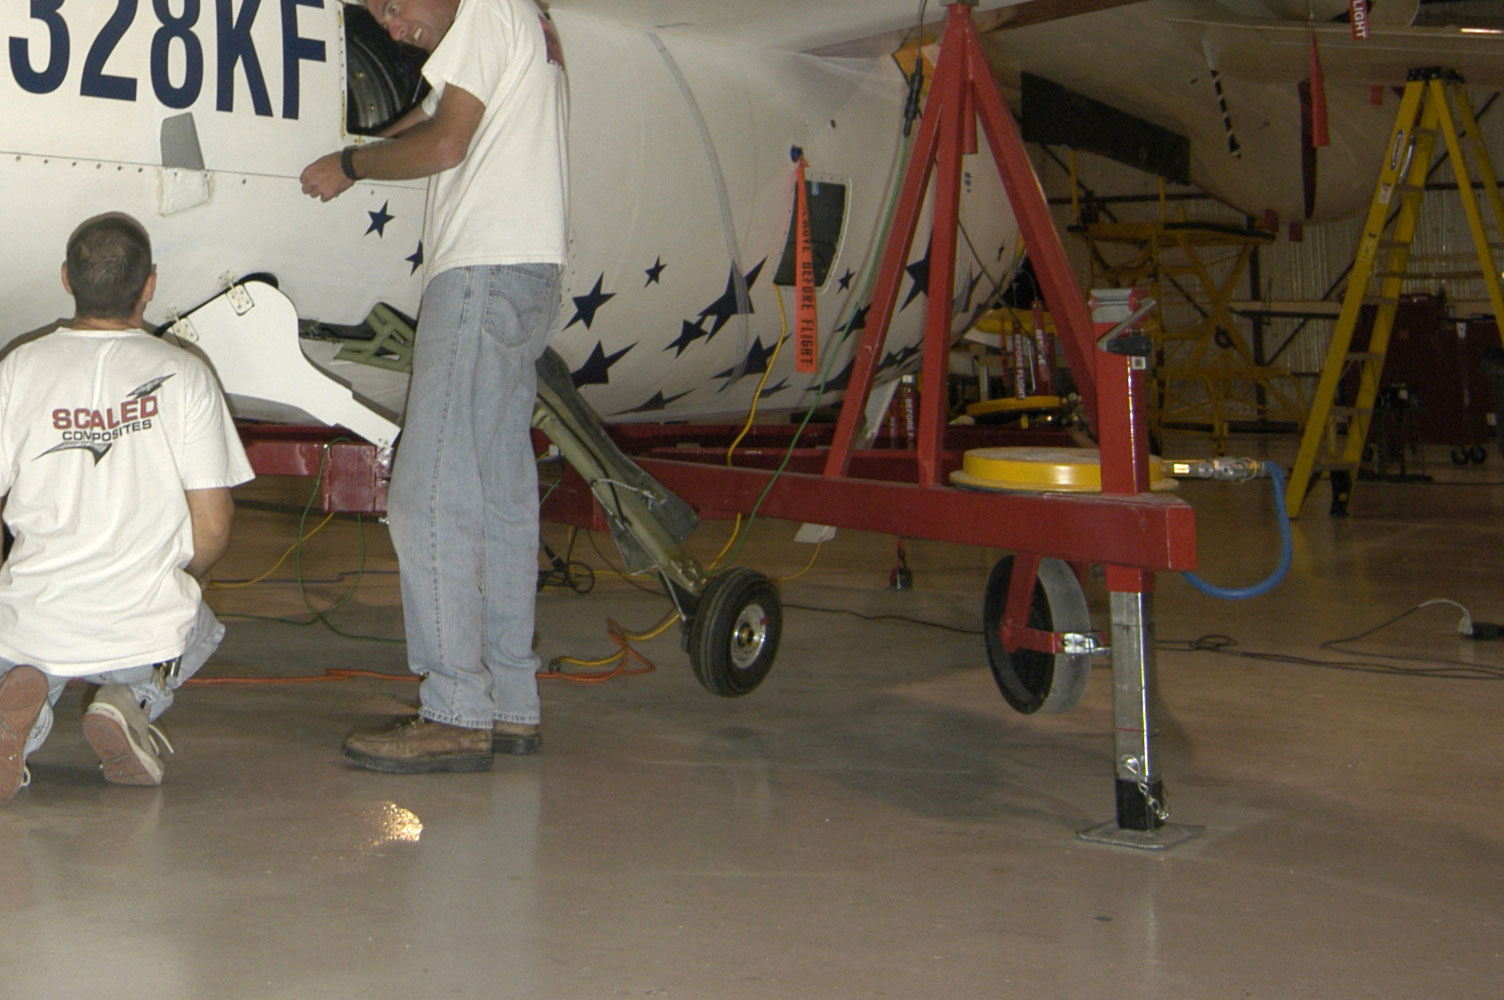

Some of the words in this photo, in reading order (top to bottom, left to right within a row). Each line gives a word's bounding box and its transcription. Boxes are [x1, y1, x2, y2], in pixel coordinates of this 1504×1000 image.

[800, 261, 815, 310] BEFORE
[799, 319, 815, 366] FLIGHT
[52, 395, 159, 431] SCALED
[62, 418, 152, 442] COMPOSITES
